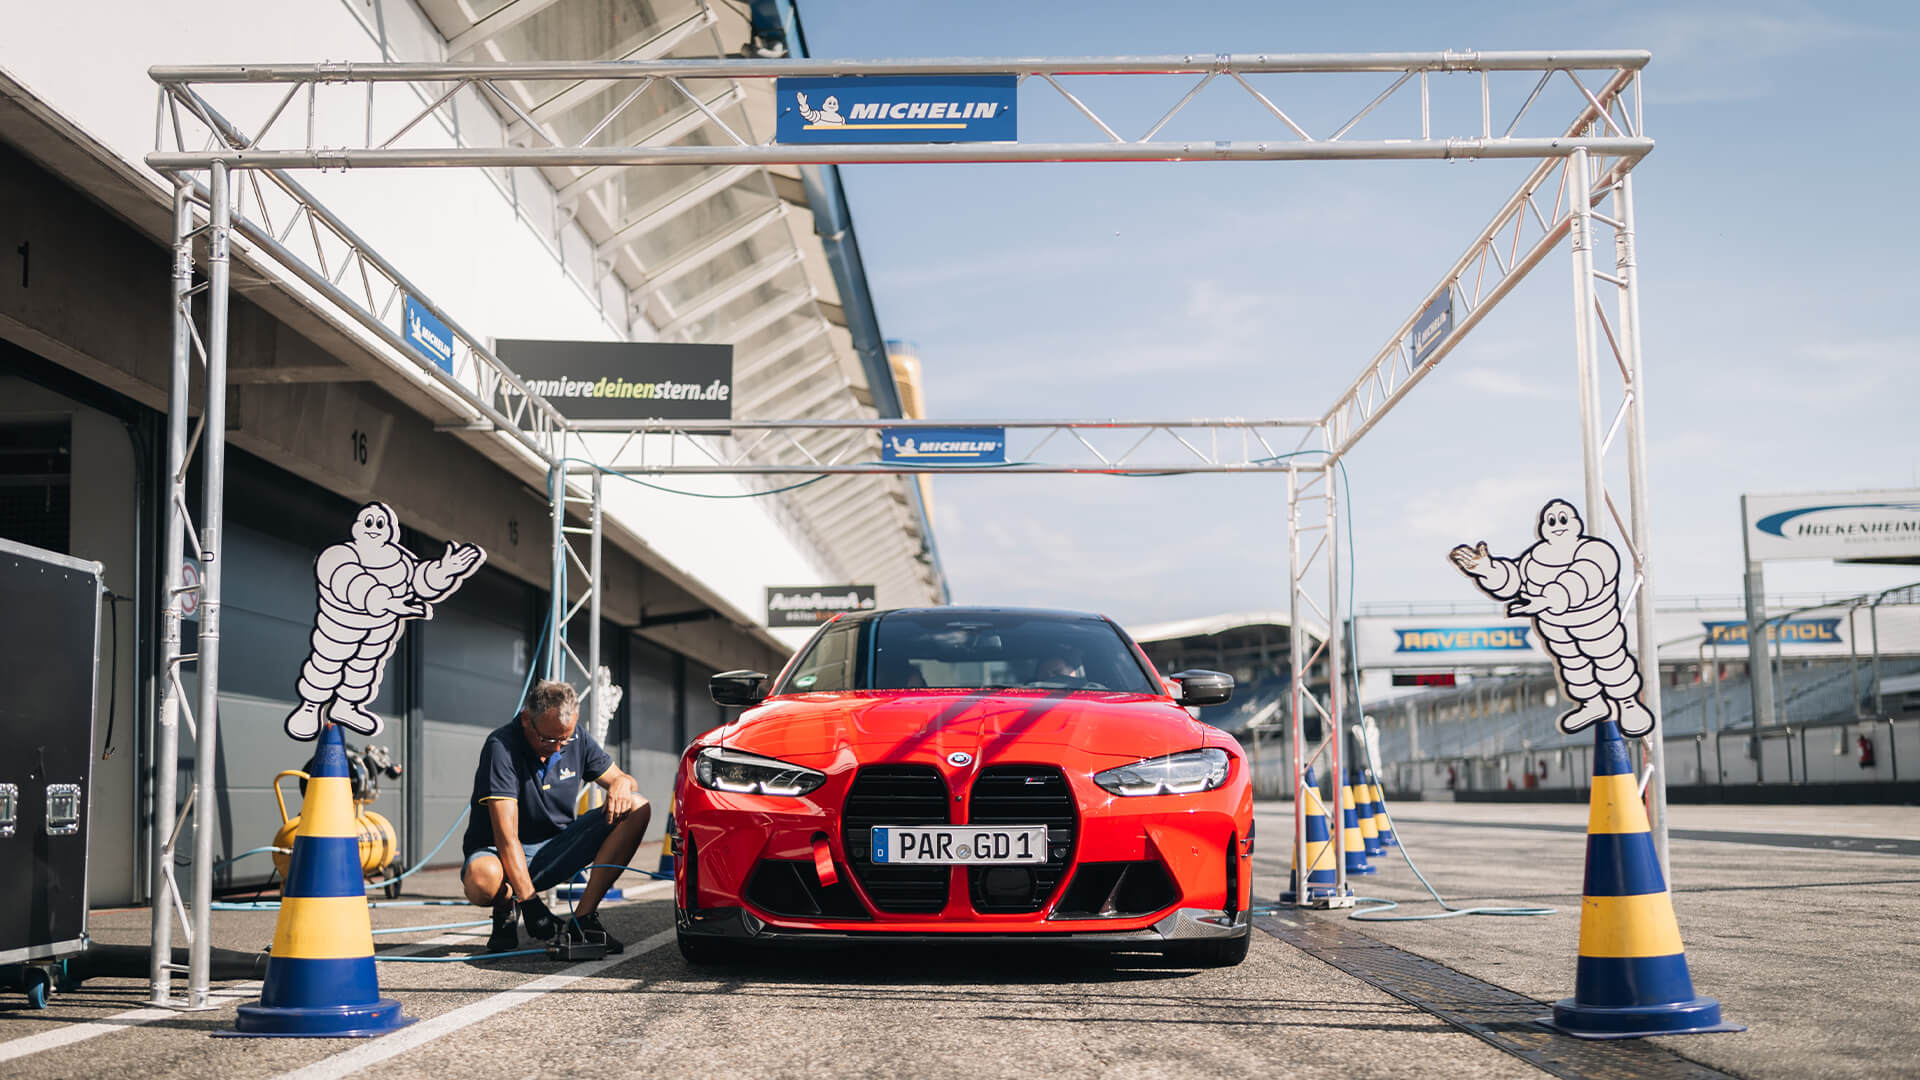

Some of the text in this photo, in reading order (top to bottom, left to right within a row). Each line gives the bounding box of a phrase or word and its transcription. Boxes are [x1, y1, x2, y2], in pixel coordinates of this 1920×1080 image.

[849, 102, 999, 120] MICHELIN
[421, 325, 452, 359] MICHELIN
[351, 429, 368, 466] 16
[919, 441, 996, 452] MICHELIN
[1797, 520, 1920, 537] HOCKENHEIM
[1404, 630, 1523, 648] RAVENOL
[1713, 623, 1833, 641] RAENOL
[899, 832, 1033, 860] PAR GD 1
